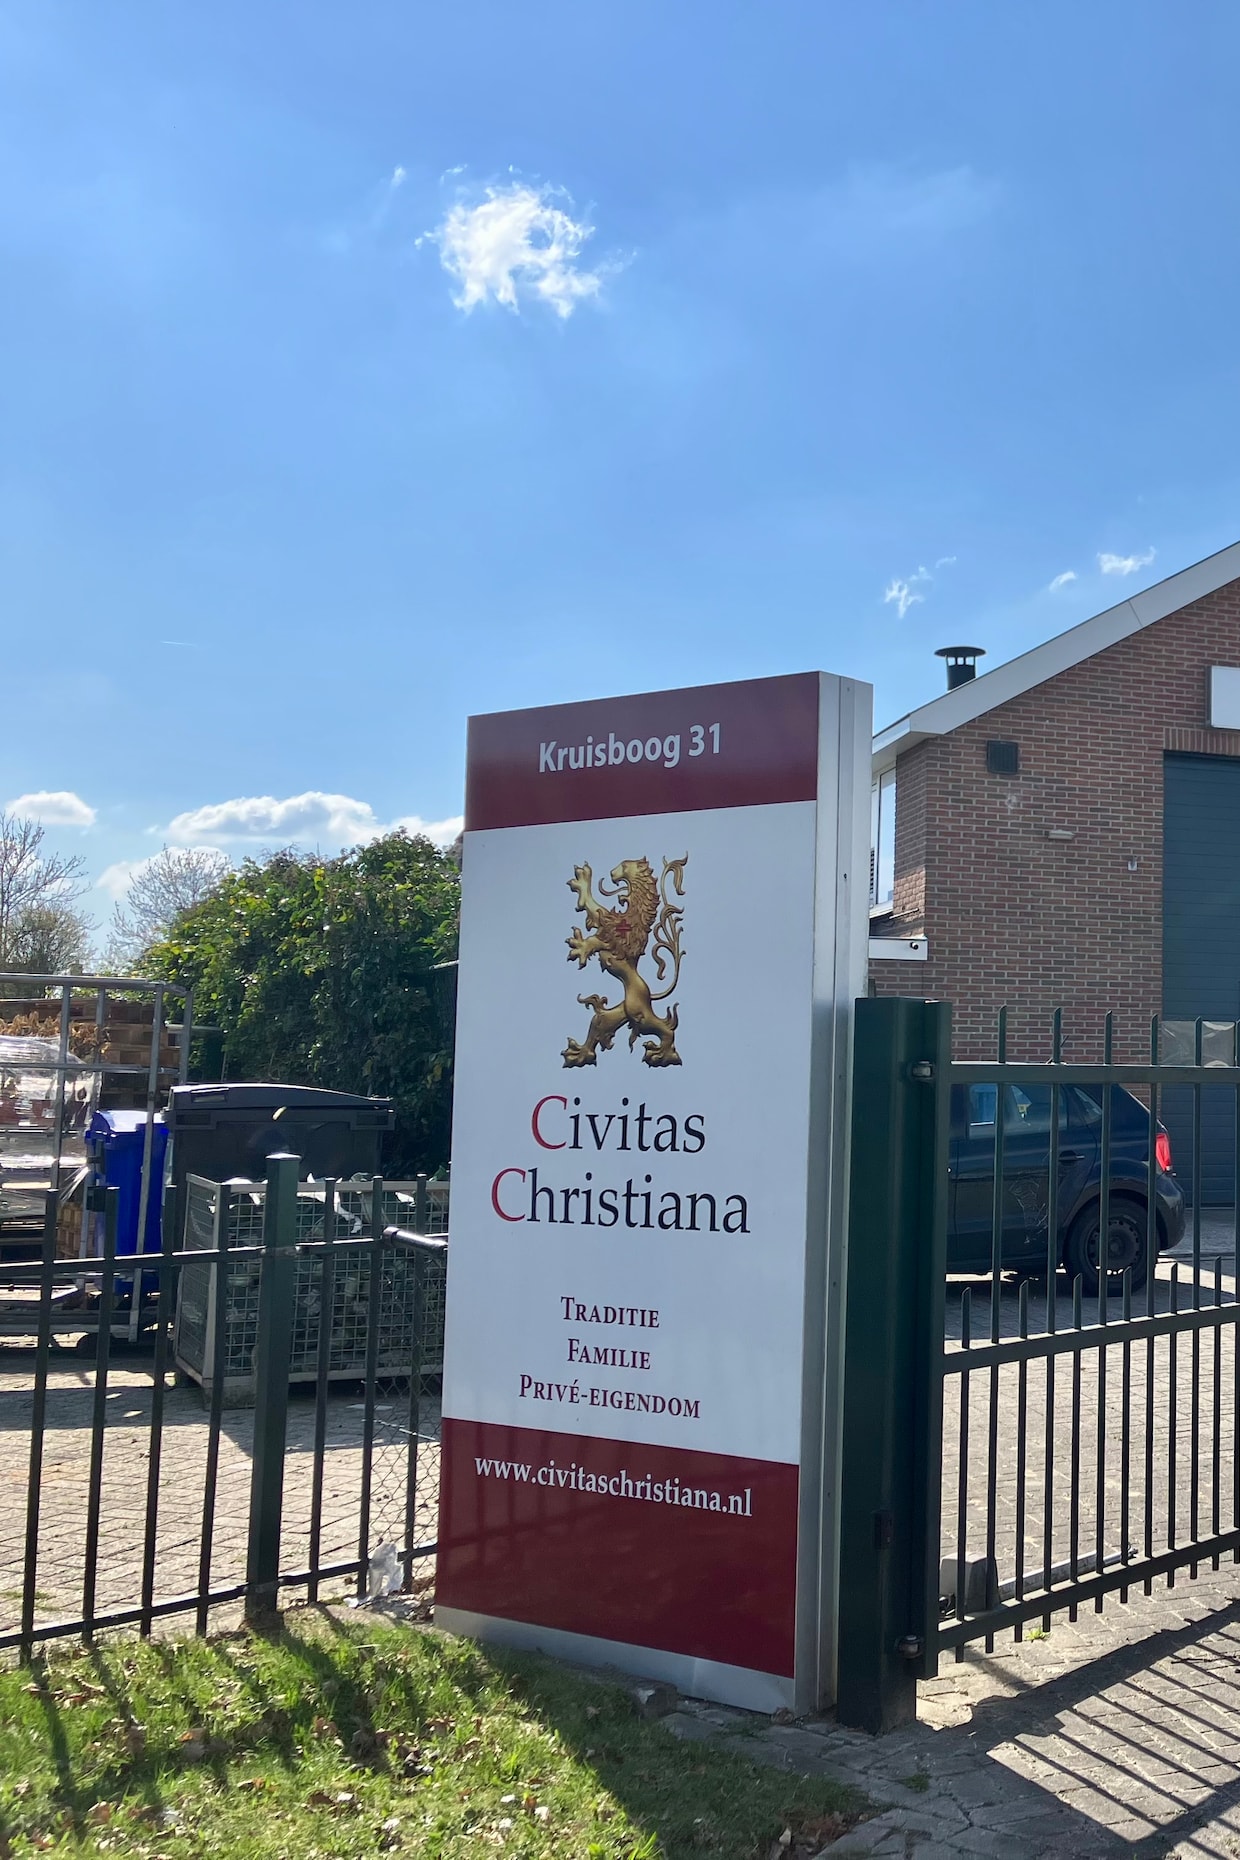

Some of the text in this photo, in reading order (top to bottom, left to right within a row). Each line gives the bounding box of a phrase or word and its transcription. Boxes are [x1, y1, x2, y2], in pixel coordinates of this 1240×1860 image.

[538, 722, 721, 773] Kruisboog 31
[531, 1095, 706, 1153] Civitas
[491, 1167, 751, 1234] Christiana
[474, 1457, 753, 1517] www.civitaschristiana.nl
